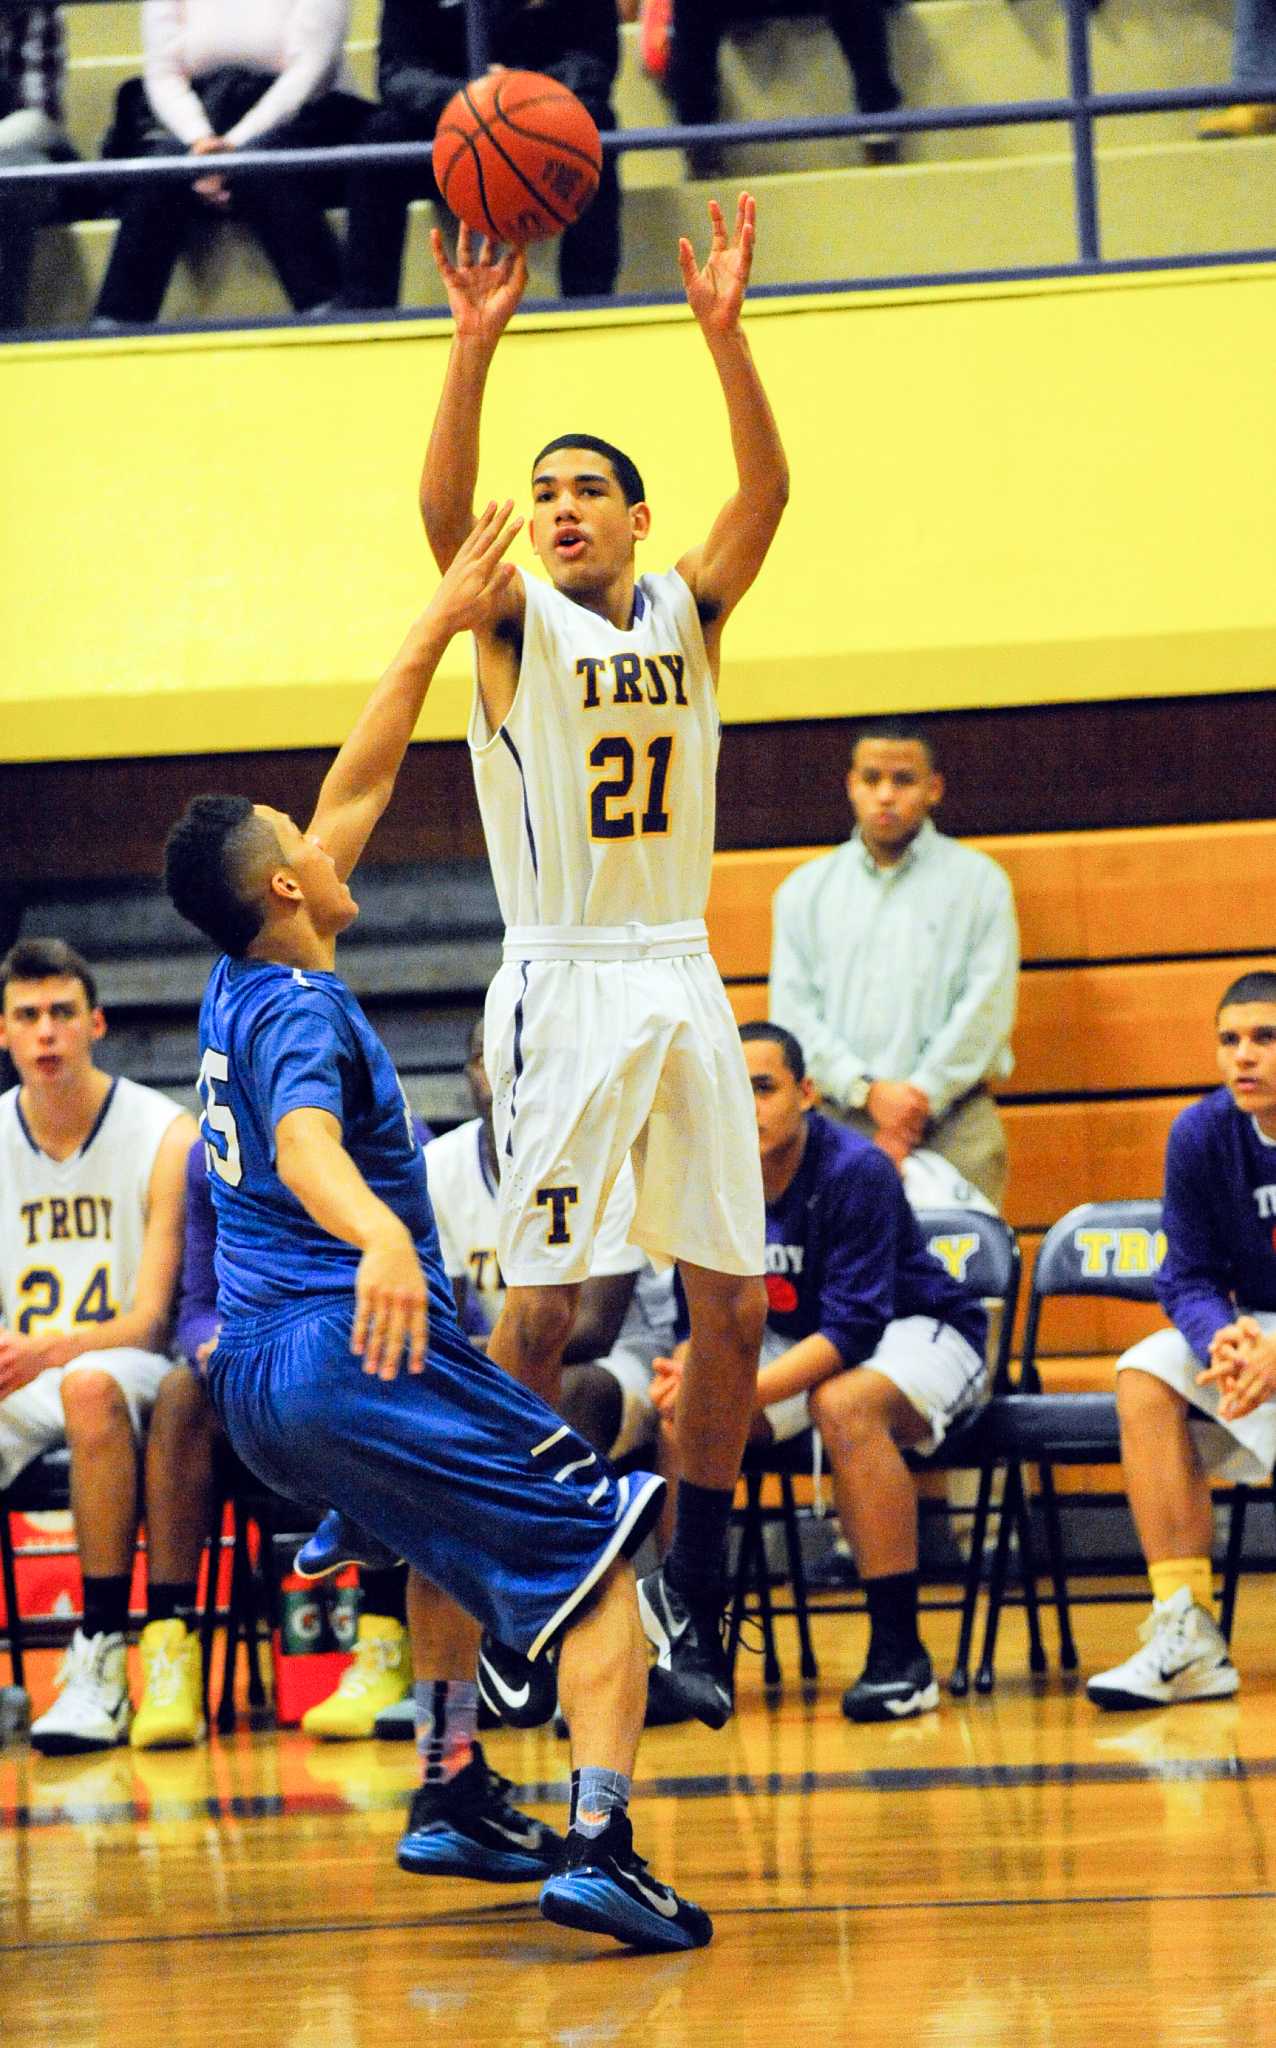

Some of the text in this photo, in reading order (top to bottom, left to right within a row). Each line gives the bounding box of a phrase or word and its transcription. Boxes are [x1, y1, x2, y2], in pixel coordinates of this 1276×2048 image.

[588, 734, 675, 840] 21
[20, 1196, 113, 1245] TROY
[535, 1185, 579, 1245] T
[469, 1249, 507, 1291] T
[927, 1233, 980, 1283] Y
[18, 1266, 120, 1335] 24
